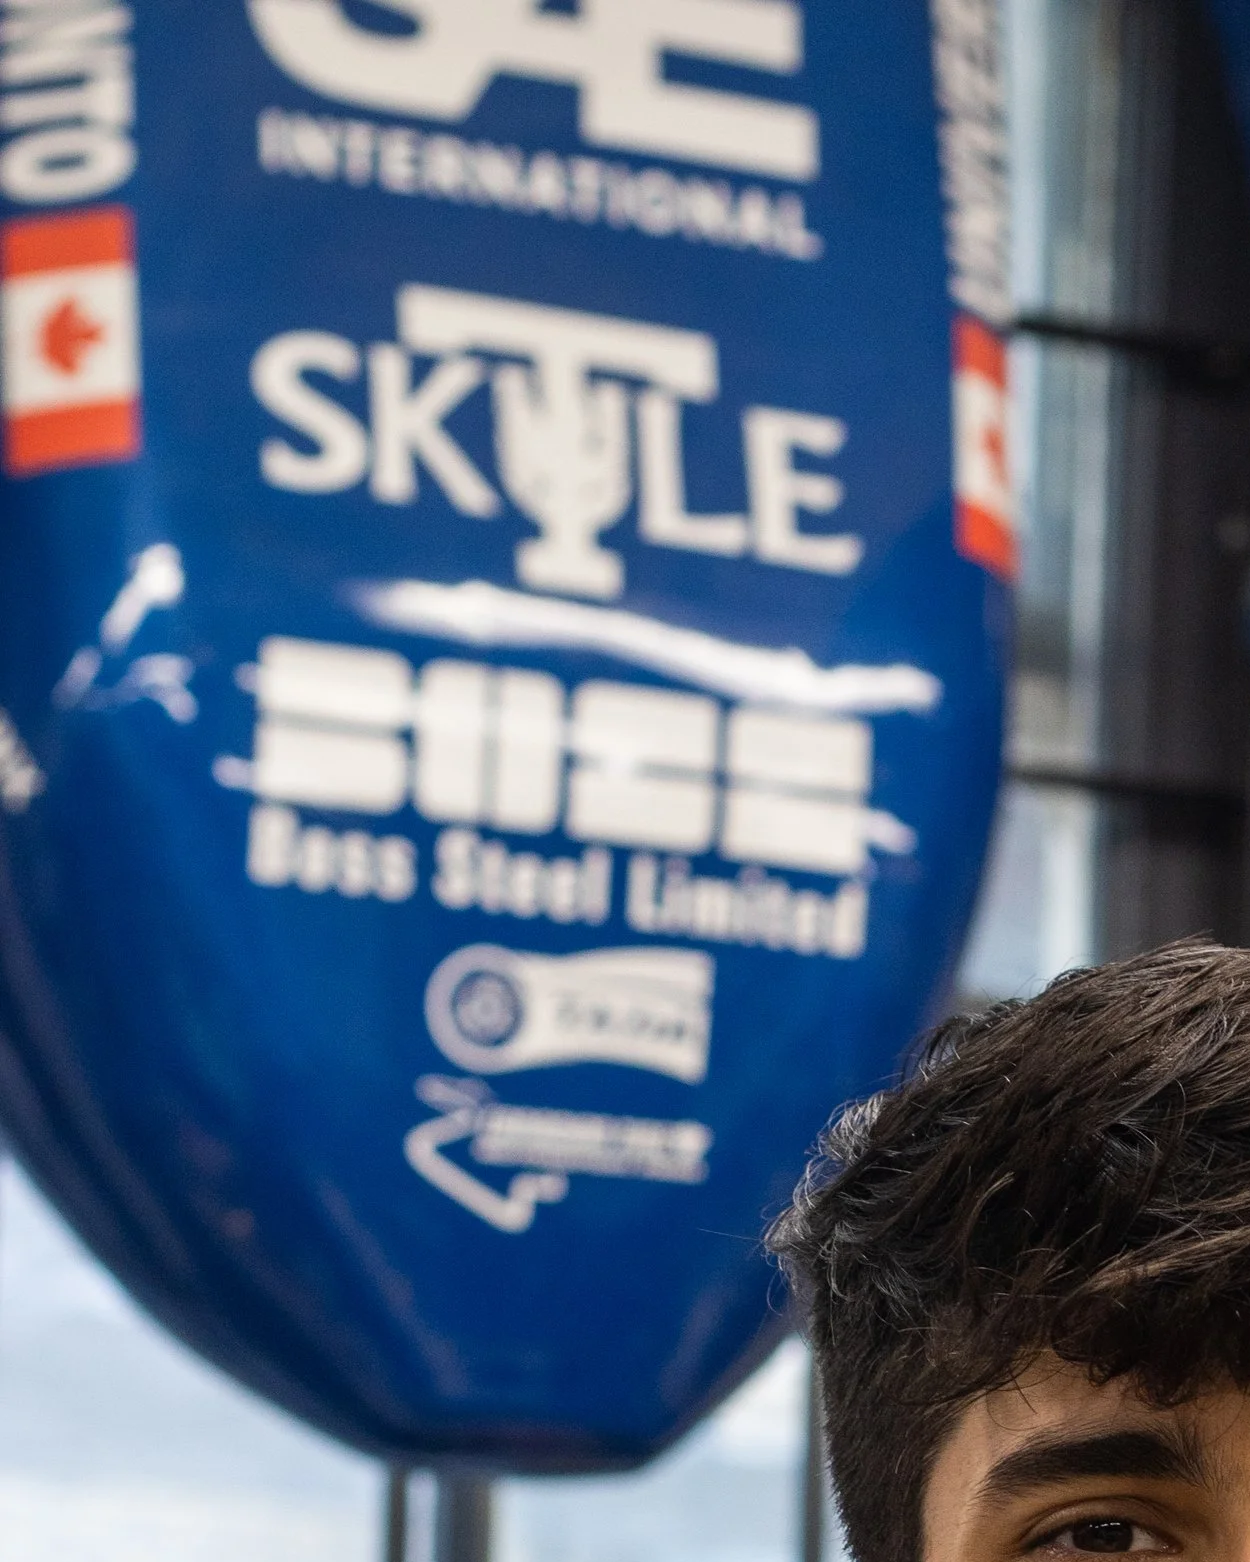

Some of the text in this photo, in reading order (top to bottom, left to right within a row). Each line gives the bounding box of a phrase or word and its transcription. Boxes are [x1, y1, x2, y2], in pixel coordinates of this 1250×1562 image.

[256, 105, 826, 261] INTERNATIONAL
[432, 827, 613, 925] Steel
[625, 852, 870, 960] Limited
